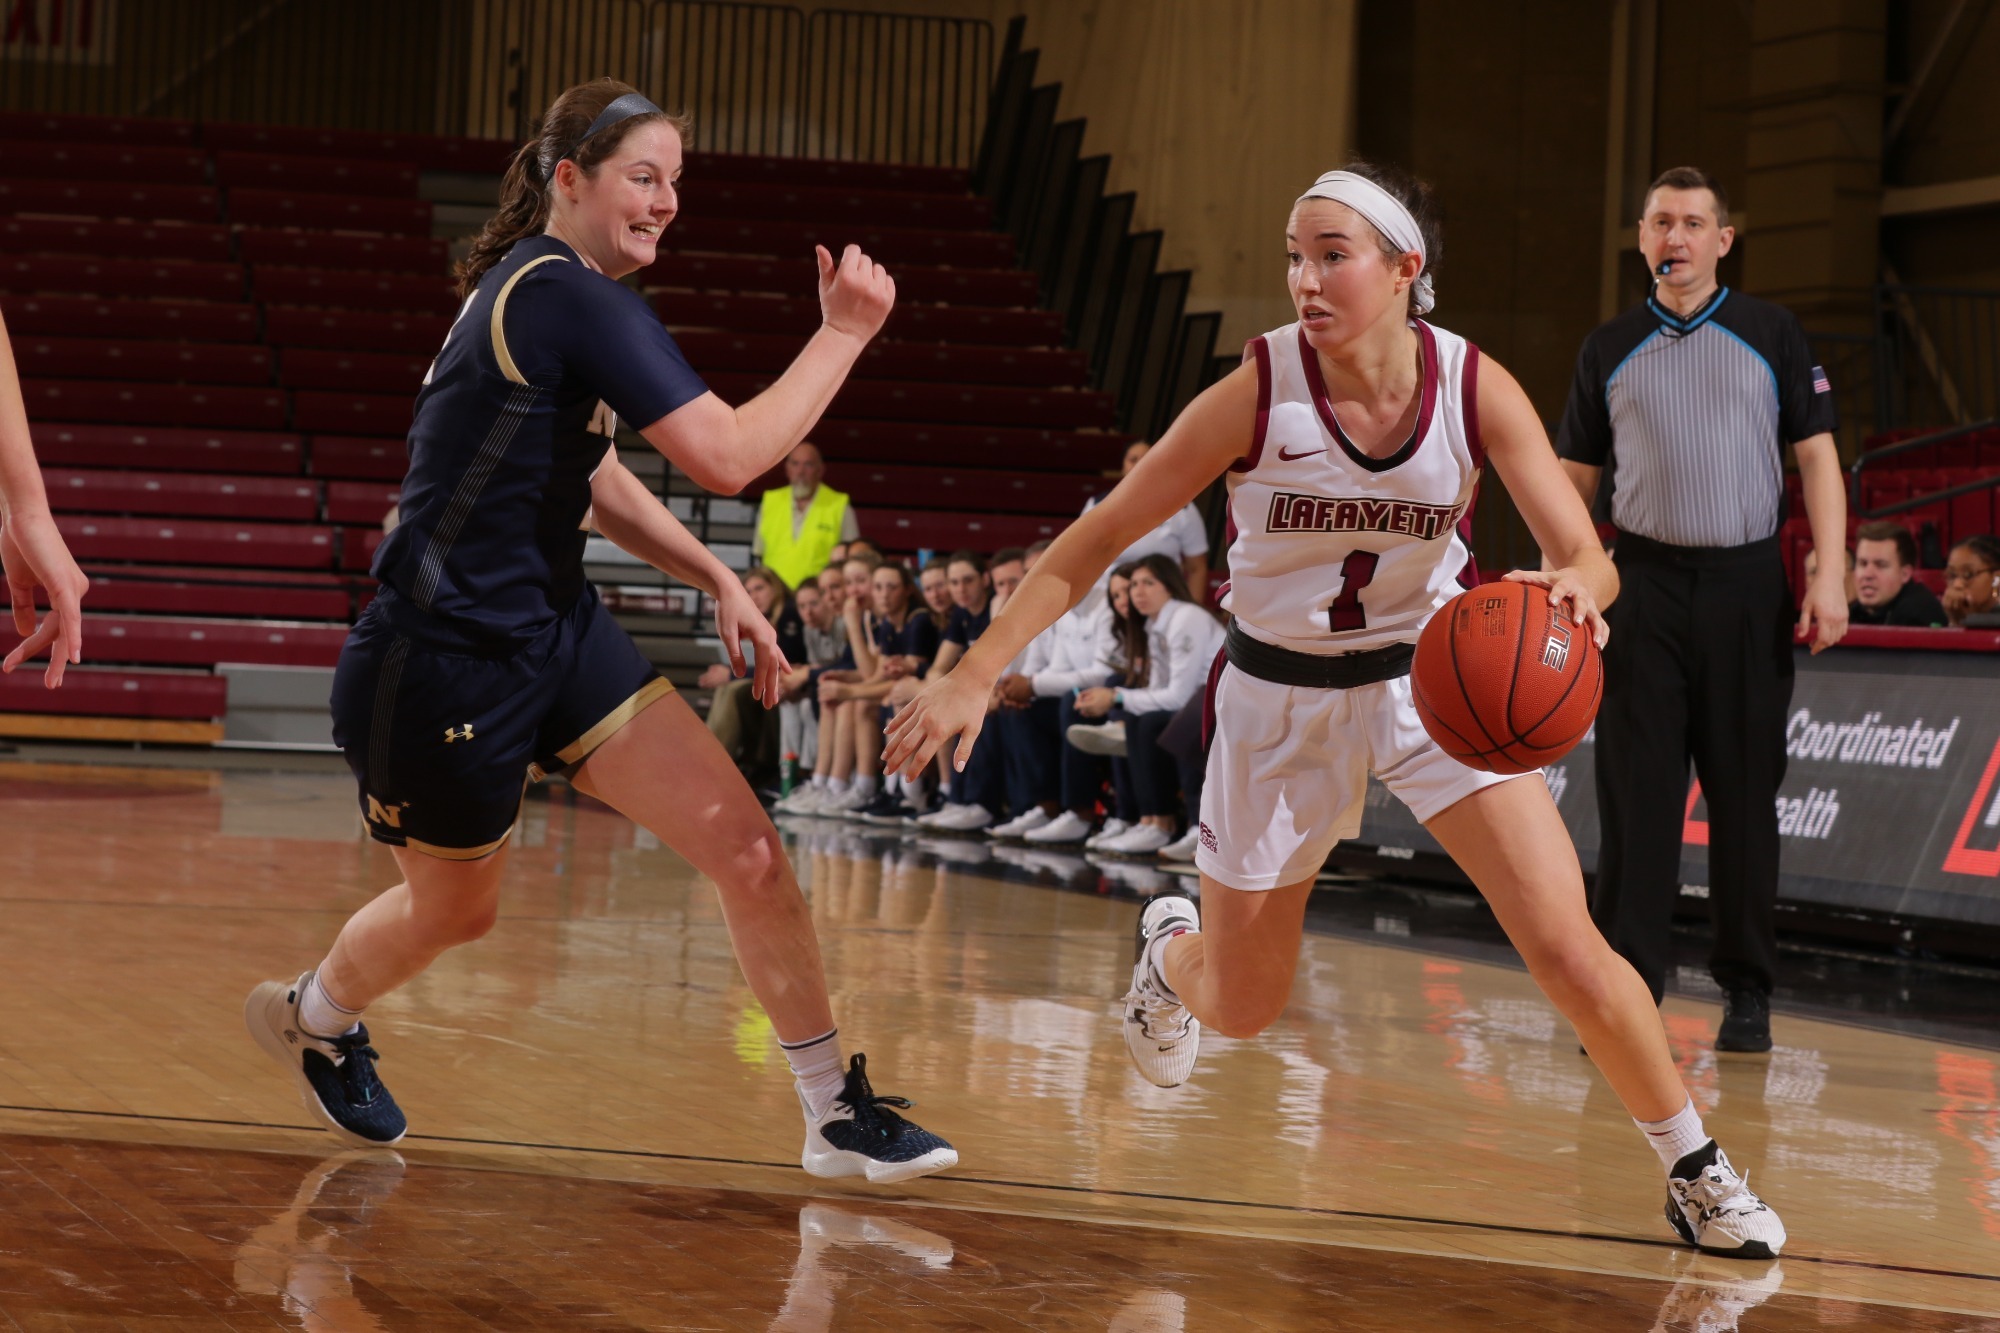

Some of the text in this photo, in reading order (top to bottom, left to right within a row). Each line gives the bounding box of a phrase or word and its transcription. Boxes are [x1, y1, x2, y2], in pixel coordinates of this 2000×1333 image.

[1328, 549, 1379, 632] 1
[1786, 708, 1960, 768] Coordinated
[367, 793, 401, 828] N
[1775, 787, 1840, 839] ealth
